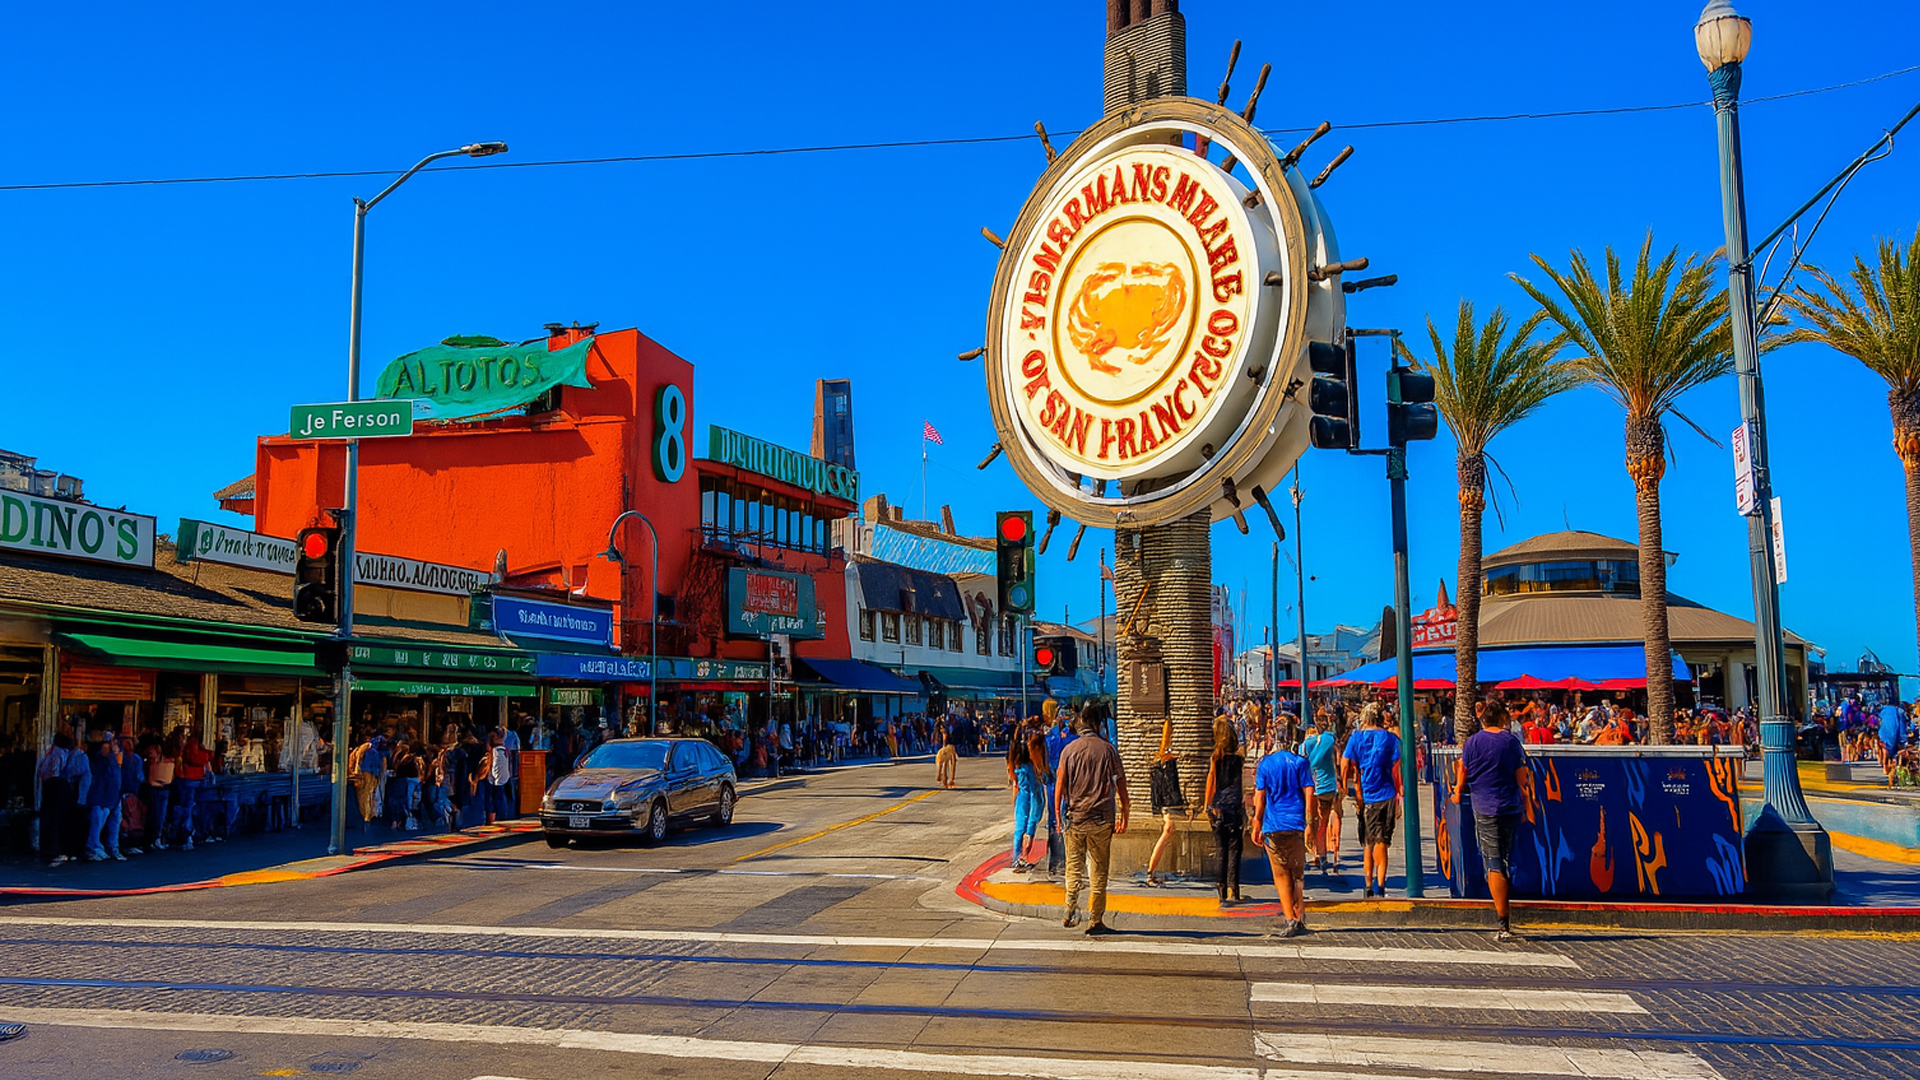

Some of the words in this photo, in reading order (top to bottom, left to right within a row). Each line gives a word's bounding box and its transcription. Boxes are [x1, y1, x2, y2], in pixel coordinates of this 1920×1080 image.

[299, 413, 326, 436] Je
[331, 410, 400, 429] Ferson
[653, 384, 686, 483] 8
[1040, 388, 1092, 455] SAN
